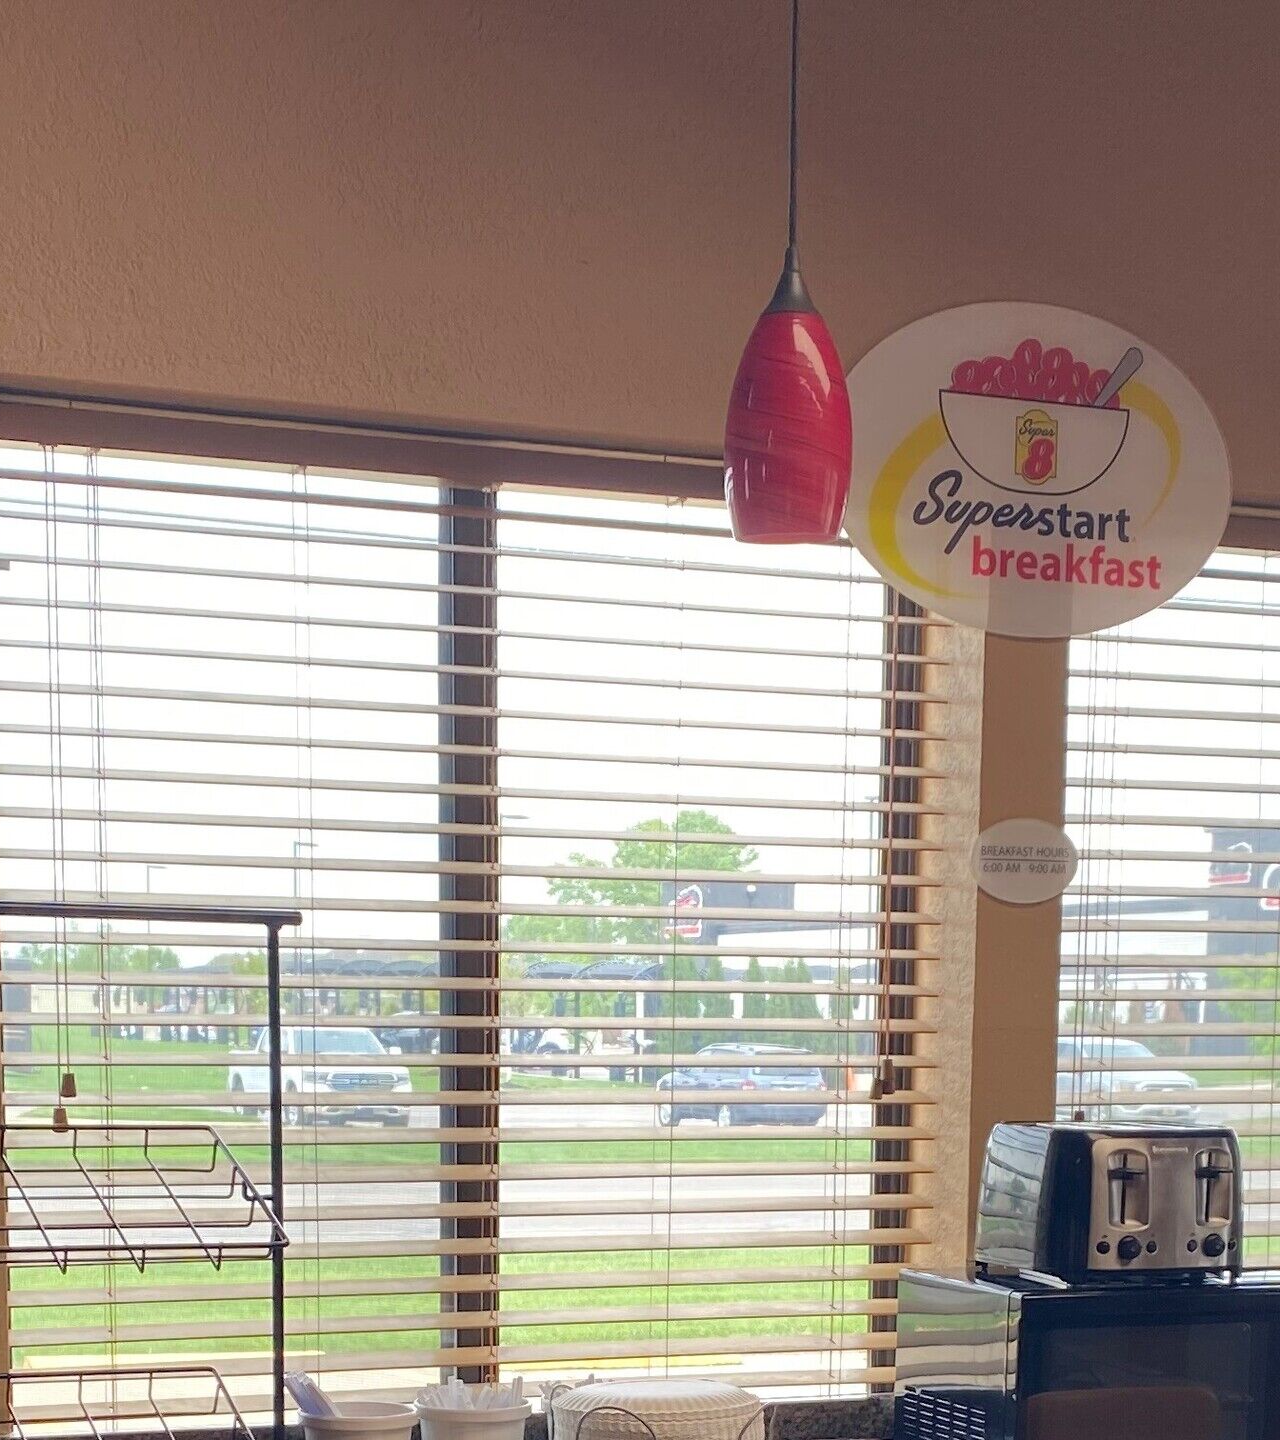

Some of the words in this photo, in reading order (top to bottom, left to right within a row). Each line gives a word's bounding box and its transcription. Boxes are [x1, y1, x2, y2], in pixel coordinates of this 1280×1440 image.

[1019, 419, 1055, 443] Super
[1024, 438, 1054, 480] 8
[913, 469, 1131, 555] Superstart
[972, 535, 1162, 590] breakfast
[981, 845, 1034, 858] BREAKFAST
[1037, 847, 1070, 858] HOURS
[983, 863, 1003, 873] 6:00
[1005, 863, 1021, 873] AM
[1028, 864, 1049, 874] 9:00
[1050, 864, 1066, 875] AM
